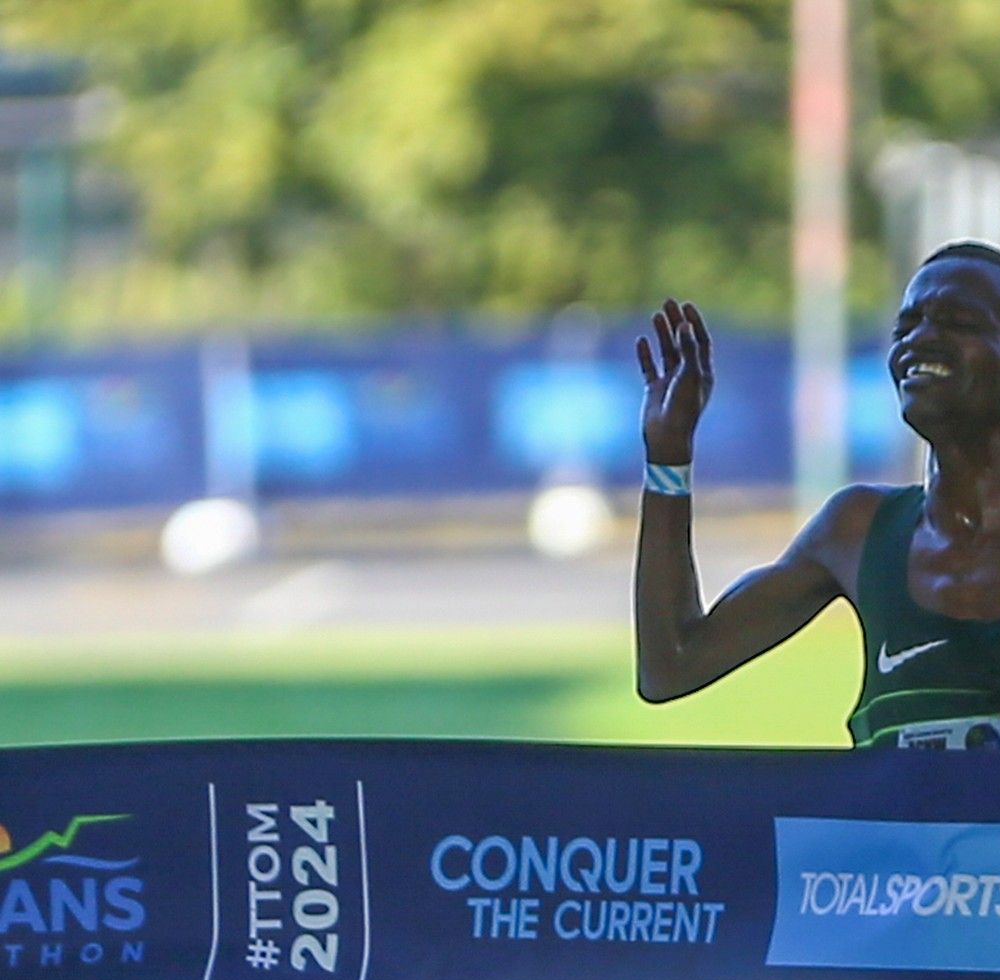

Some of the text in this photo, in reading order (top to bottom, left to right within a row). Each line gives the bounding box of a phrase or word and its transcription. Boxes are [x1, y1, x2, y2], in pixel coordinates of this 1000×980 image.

[246, 803, 283, 970] #TTOM
[290, 800, 339, 973] 2024
[430, 835, 702, 895] CONQUER
[467, 898, 725, 943] THE CURRENT
